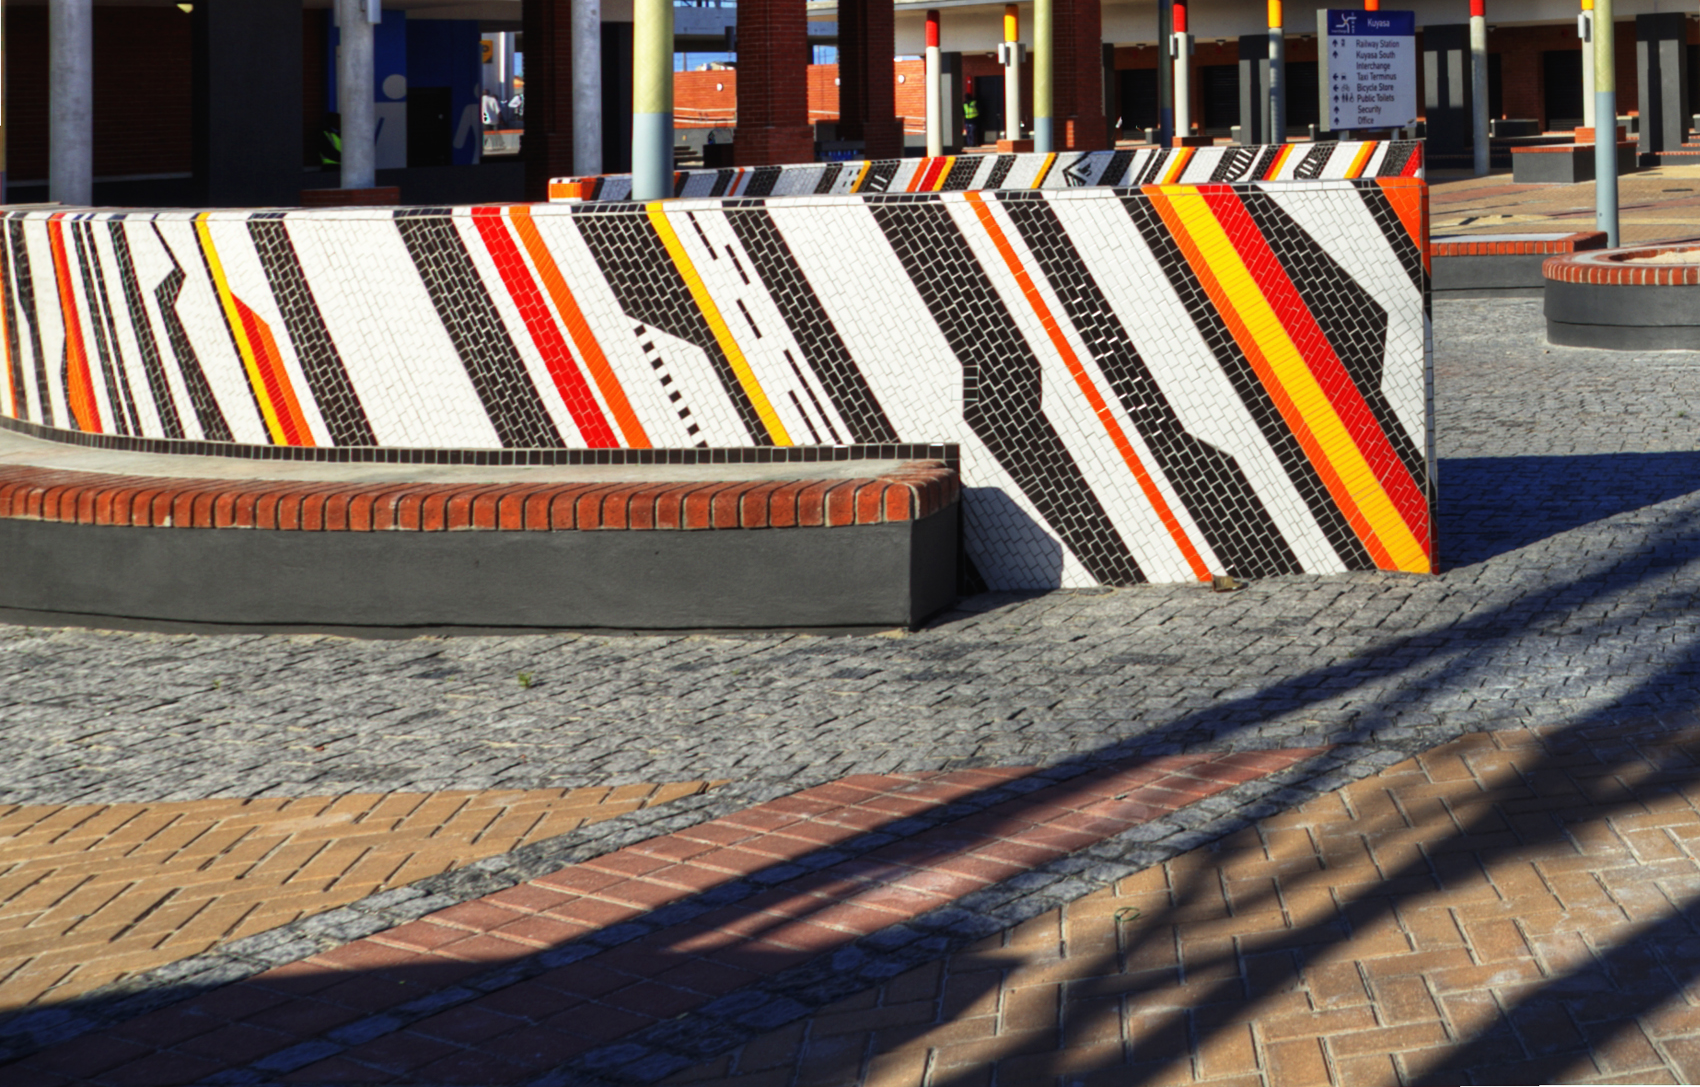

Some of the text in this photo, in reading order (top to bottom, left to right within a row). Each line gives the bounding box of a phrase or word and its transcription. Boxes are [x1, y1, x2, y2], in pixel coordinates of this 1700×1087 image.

[1367, 19, 1390, 29] Kuyasa
[1356, 39, 1400, 49] Railway Station
[1356, 51, 1395, 60] Kuyasa South
[1356, 62, 1391, 72] Interchange
[1357, 73, 1397, 81] Taxi Terminus
[1357, 83, 1394, 93] Bicycle Store
[1357, 94, 1395, 102] Public Toilets
[1357, 105, 1381, 115] Security
[1358, 116, 1374, 125] Office
